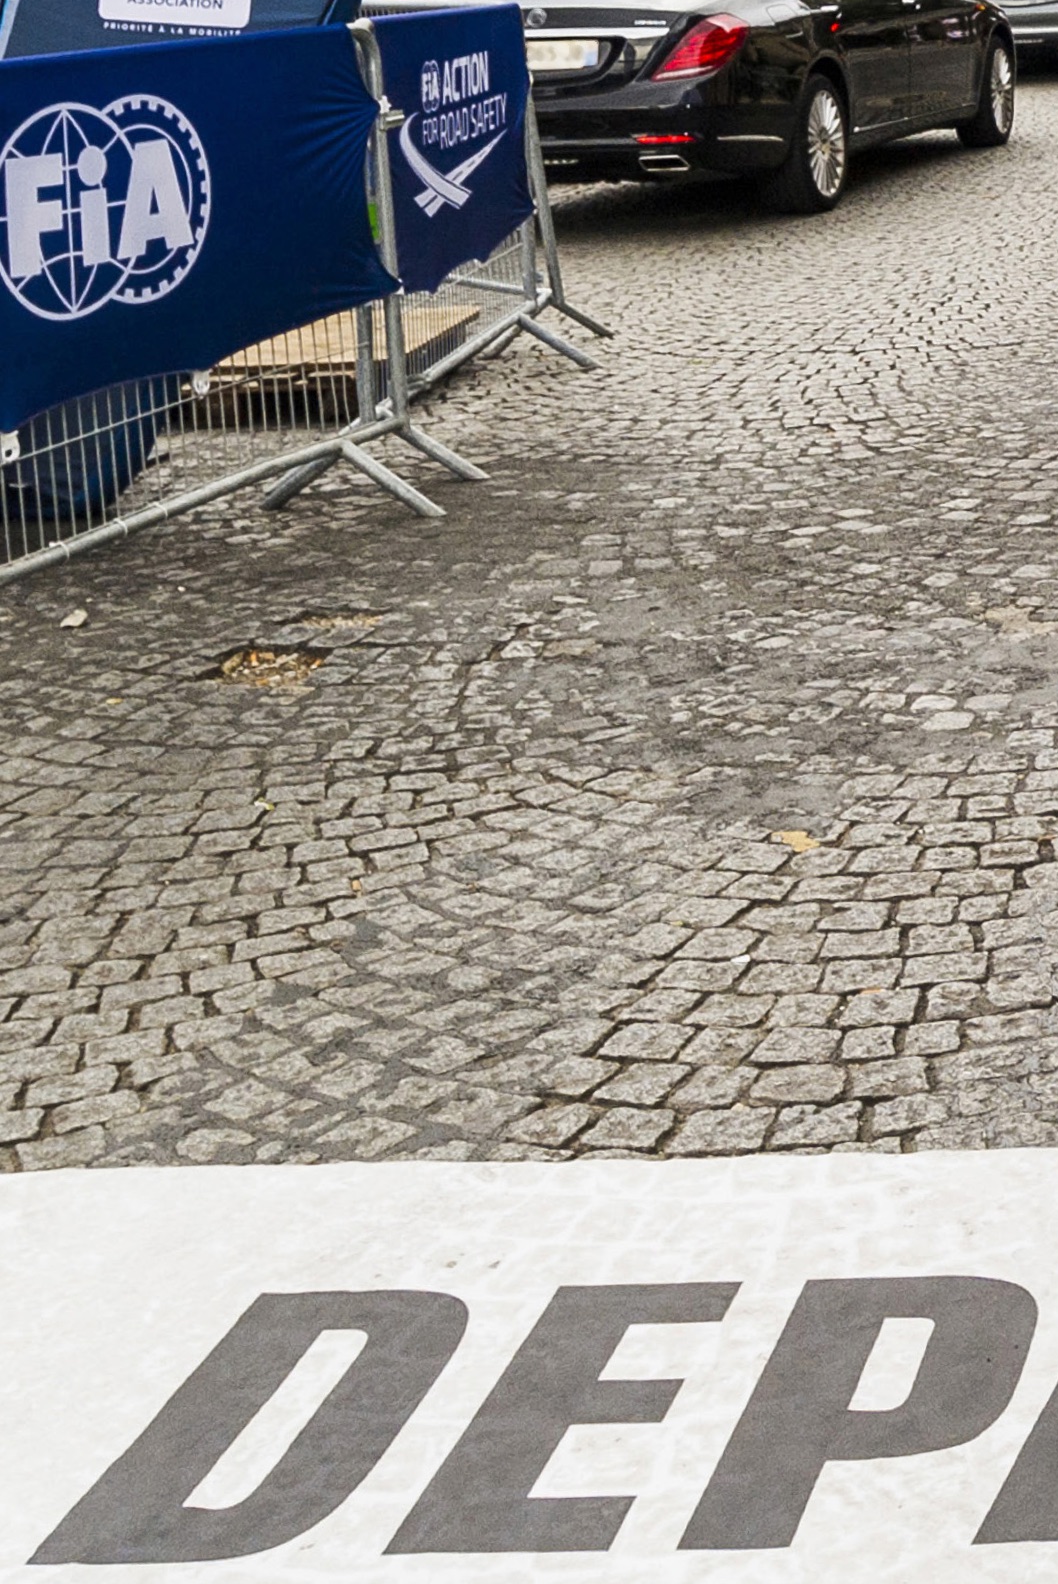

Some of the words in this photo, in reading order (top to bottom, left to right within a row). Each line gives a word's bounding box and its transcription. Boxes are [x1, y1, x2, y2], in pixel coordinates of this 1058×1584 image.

[442, 50, 489, 106] ACTION
[422, 117, 440, 146] FOR
[440, 107, 469, 150] ROAD
[470, 92, 507, 138] SAFETY
